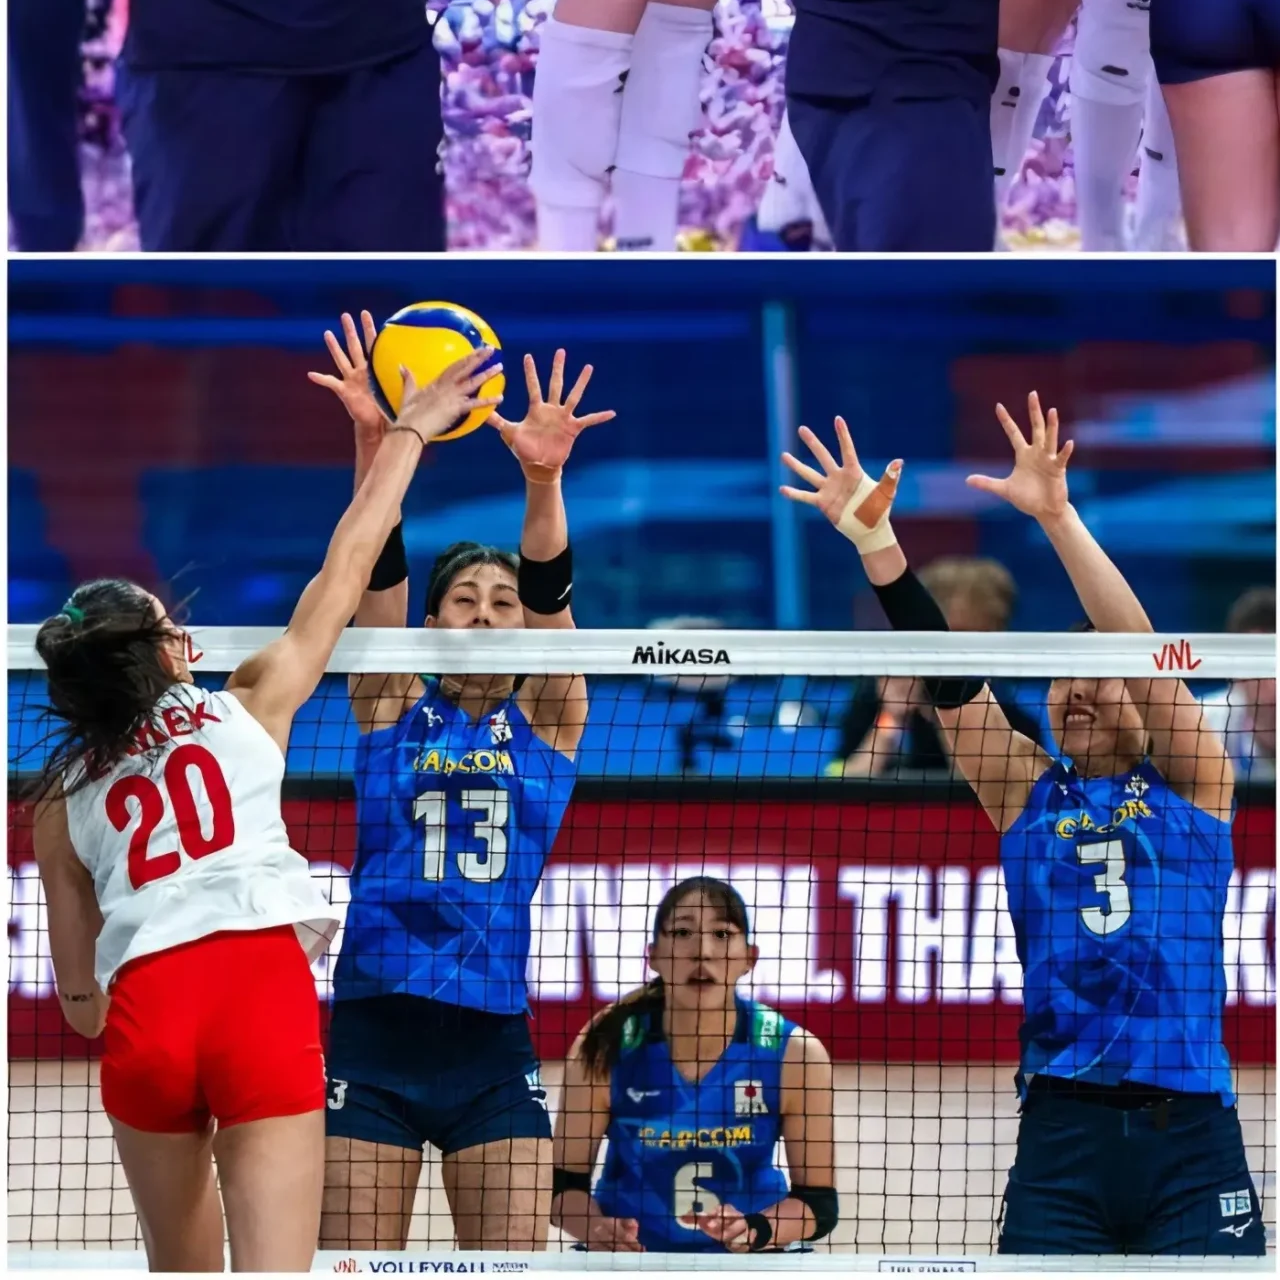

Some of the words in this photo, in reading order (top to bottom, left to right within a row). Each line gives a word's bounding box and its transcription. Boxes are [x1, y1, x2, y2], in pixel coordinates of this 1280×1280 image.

[1152, 638, 1203, 671] VNL
[105, 744, 235, 891] 20
[412, 789, 509, 884] 13
[1076, 839, 1132, 936] 3
[674, 1162, 721, 1230] 6
